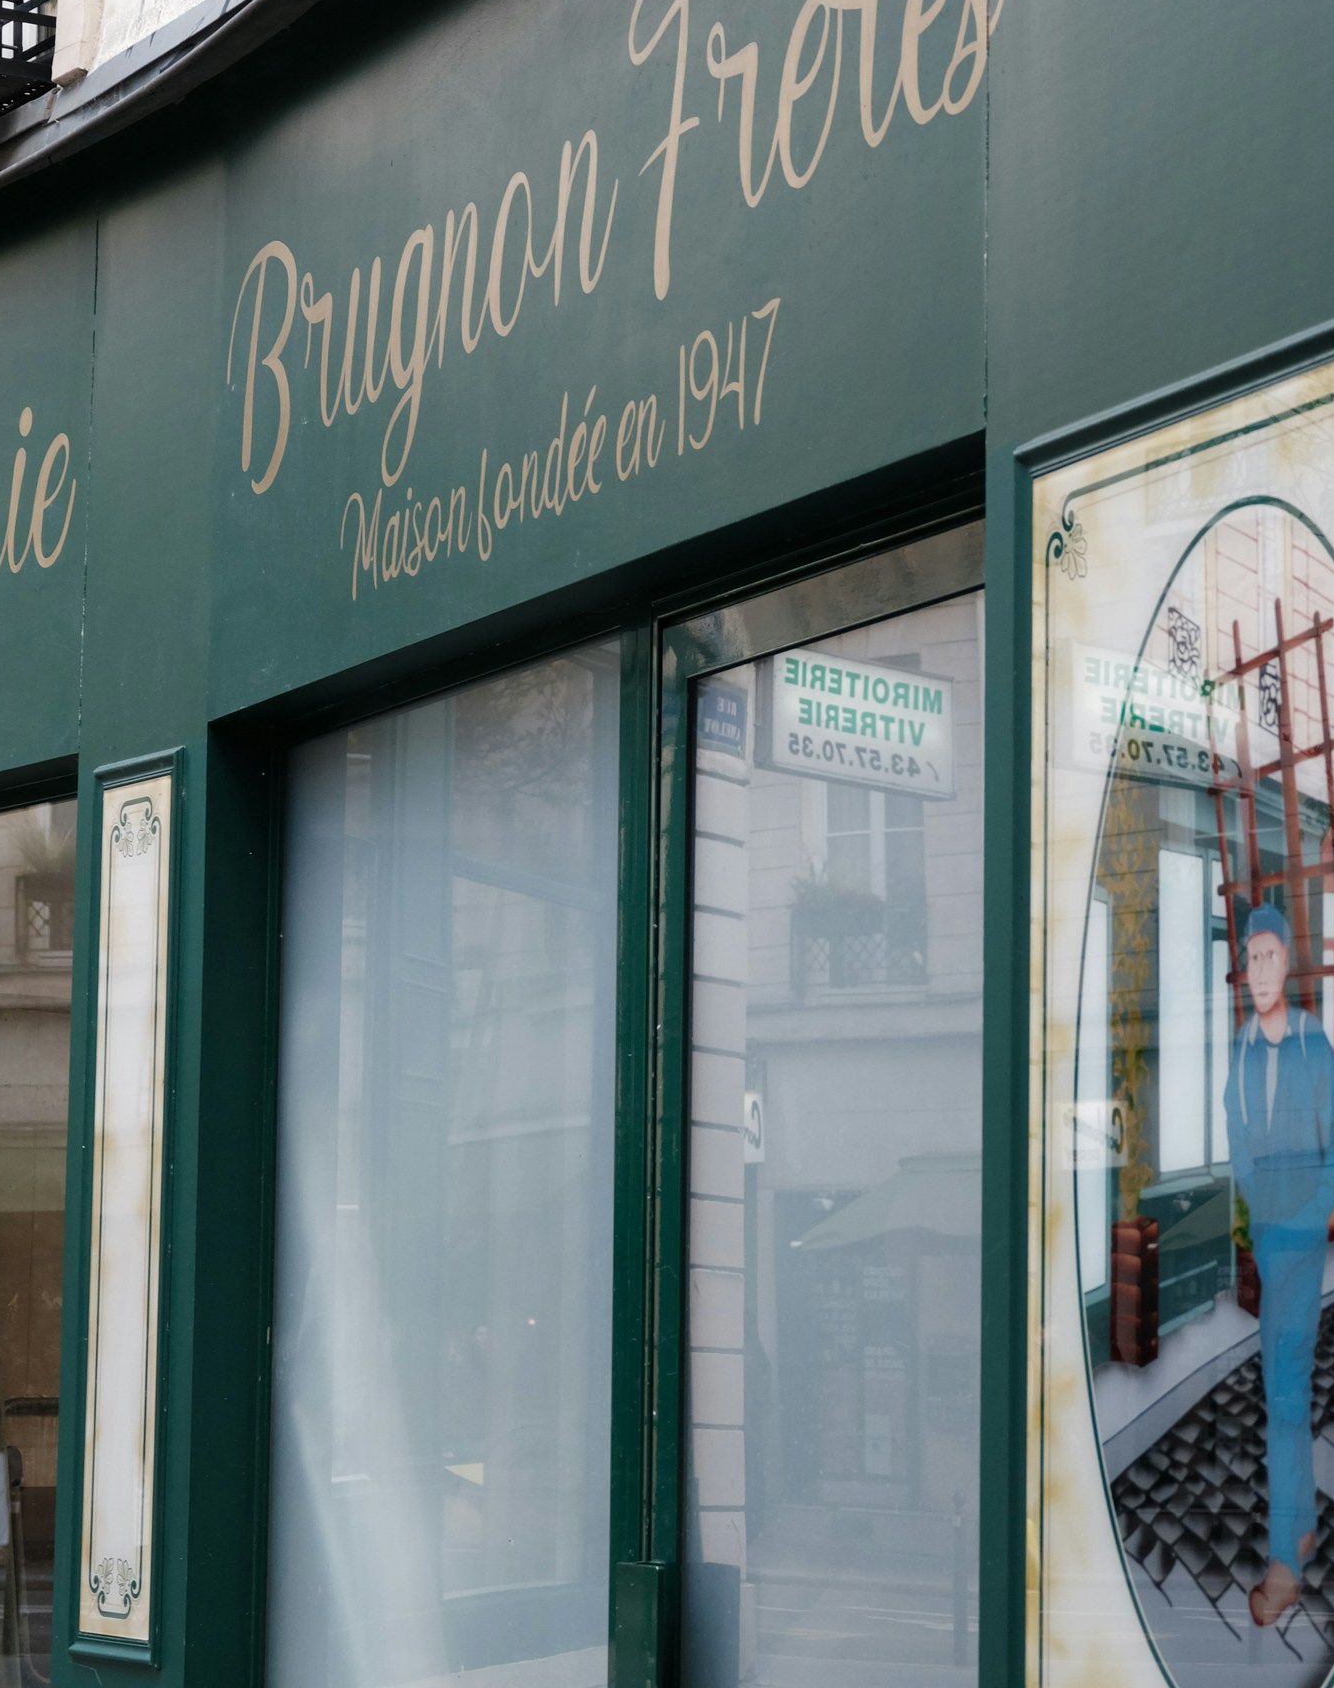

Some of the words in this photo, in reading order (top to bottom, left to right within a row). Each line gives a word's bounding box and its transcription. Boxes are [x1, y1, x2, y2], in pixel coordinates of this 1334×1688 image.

[228, 129, 618, 494] Brugnon
[341, 484, 470, 601] Maison
[472, 386, 607, 561] fondée
[616, 393, 666, 482] en
[677, 298, 781, 457] 1947
